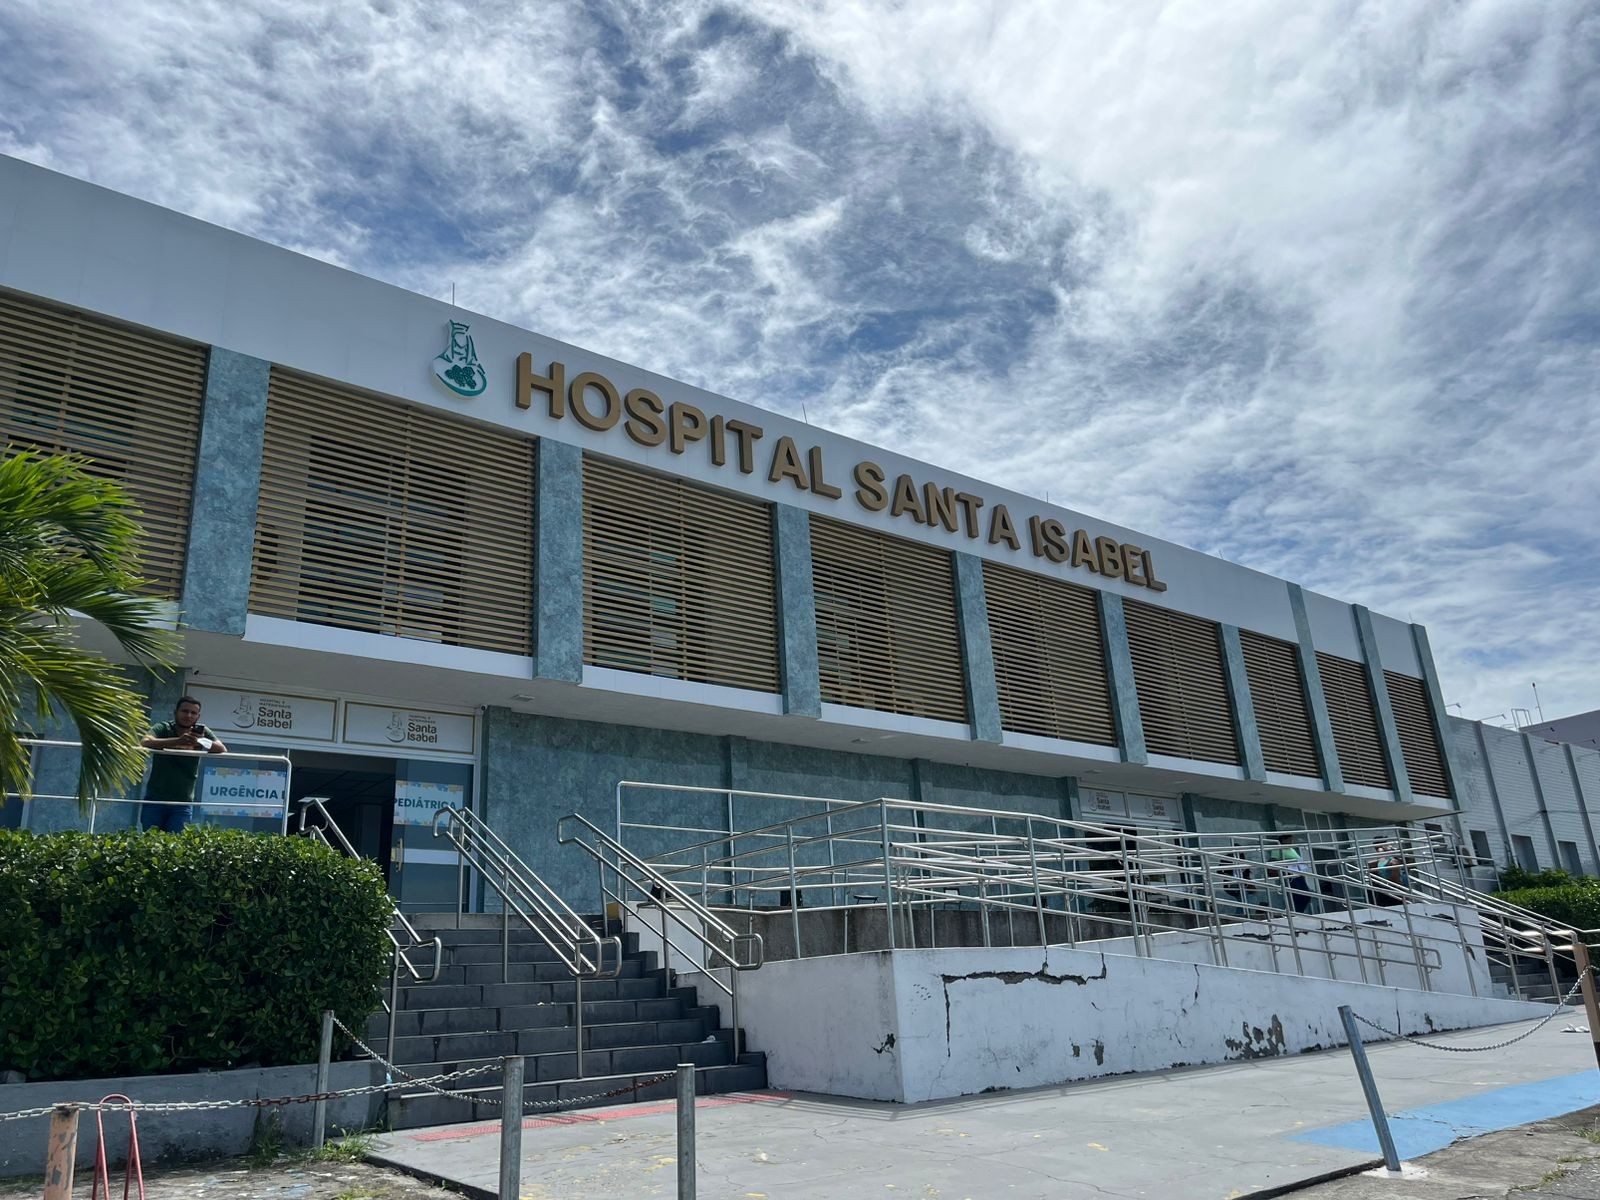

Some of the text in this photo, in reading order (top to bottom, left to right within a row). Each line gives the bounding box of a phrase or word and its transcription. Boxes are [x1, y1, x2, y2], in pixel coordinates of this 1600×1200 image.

[515, 352, 1167, 592] HOSPITAL SANTA ISABEL
[258, 706, 292, 719] Santa
[257, 717, 292, 730] Isabel
[408, 722, 437, 734] Santa
[407, 732, 438, 743] Isabel
[210, 785, 278, 799] URGÊNCIA
